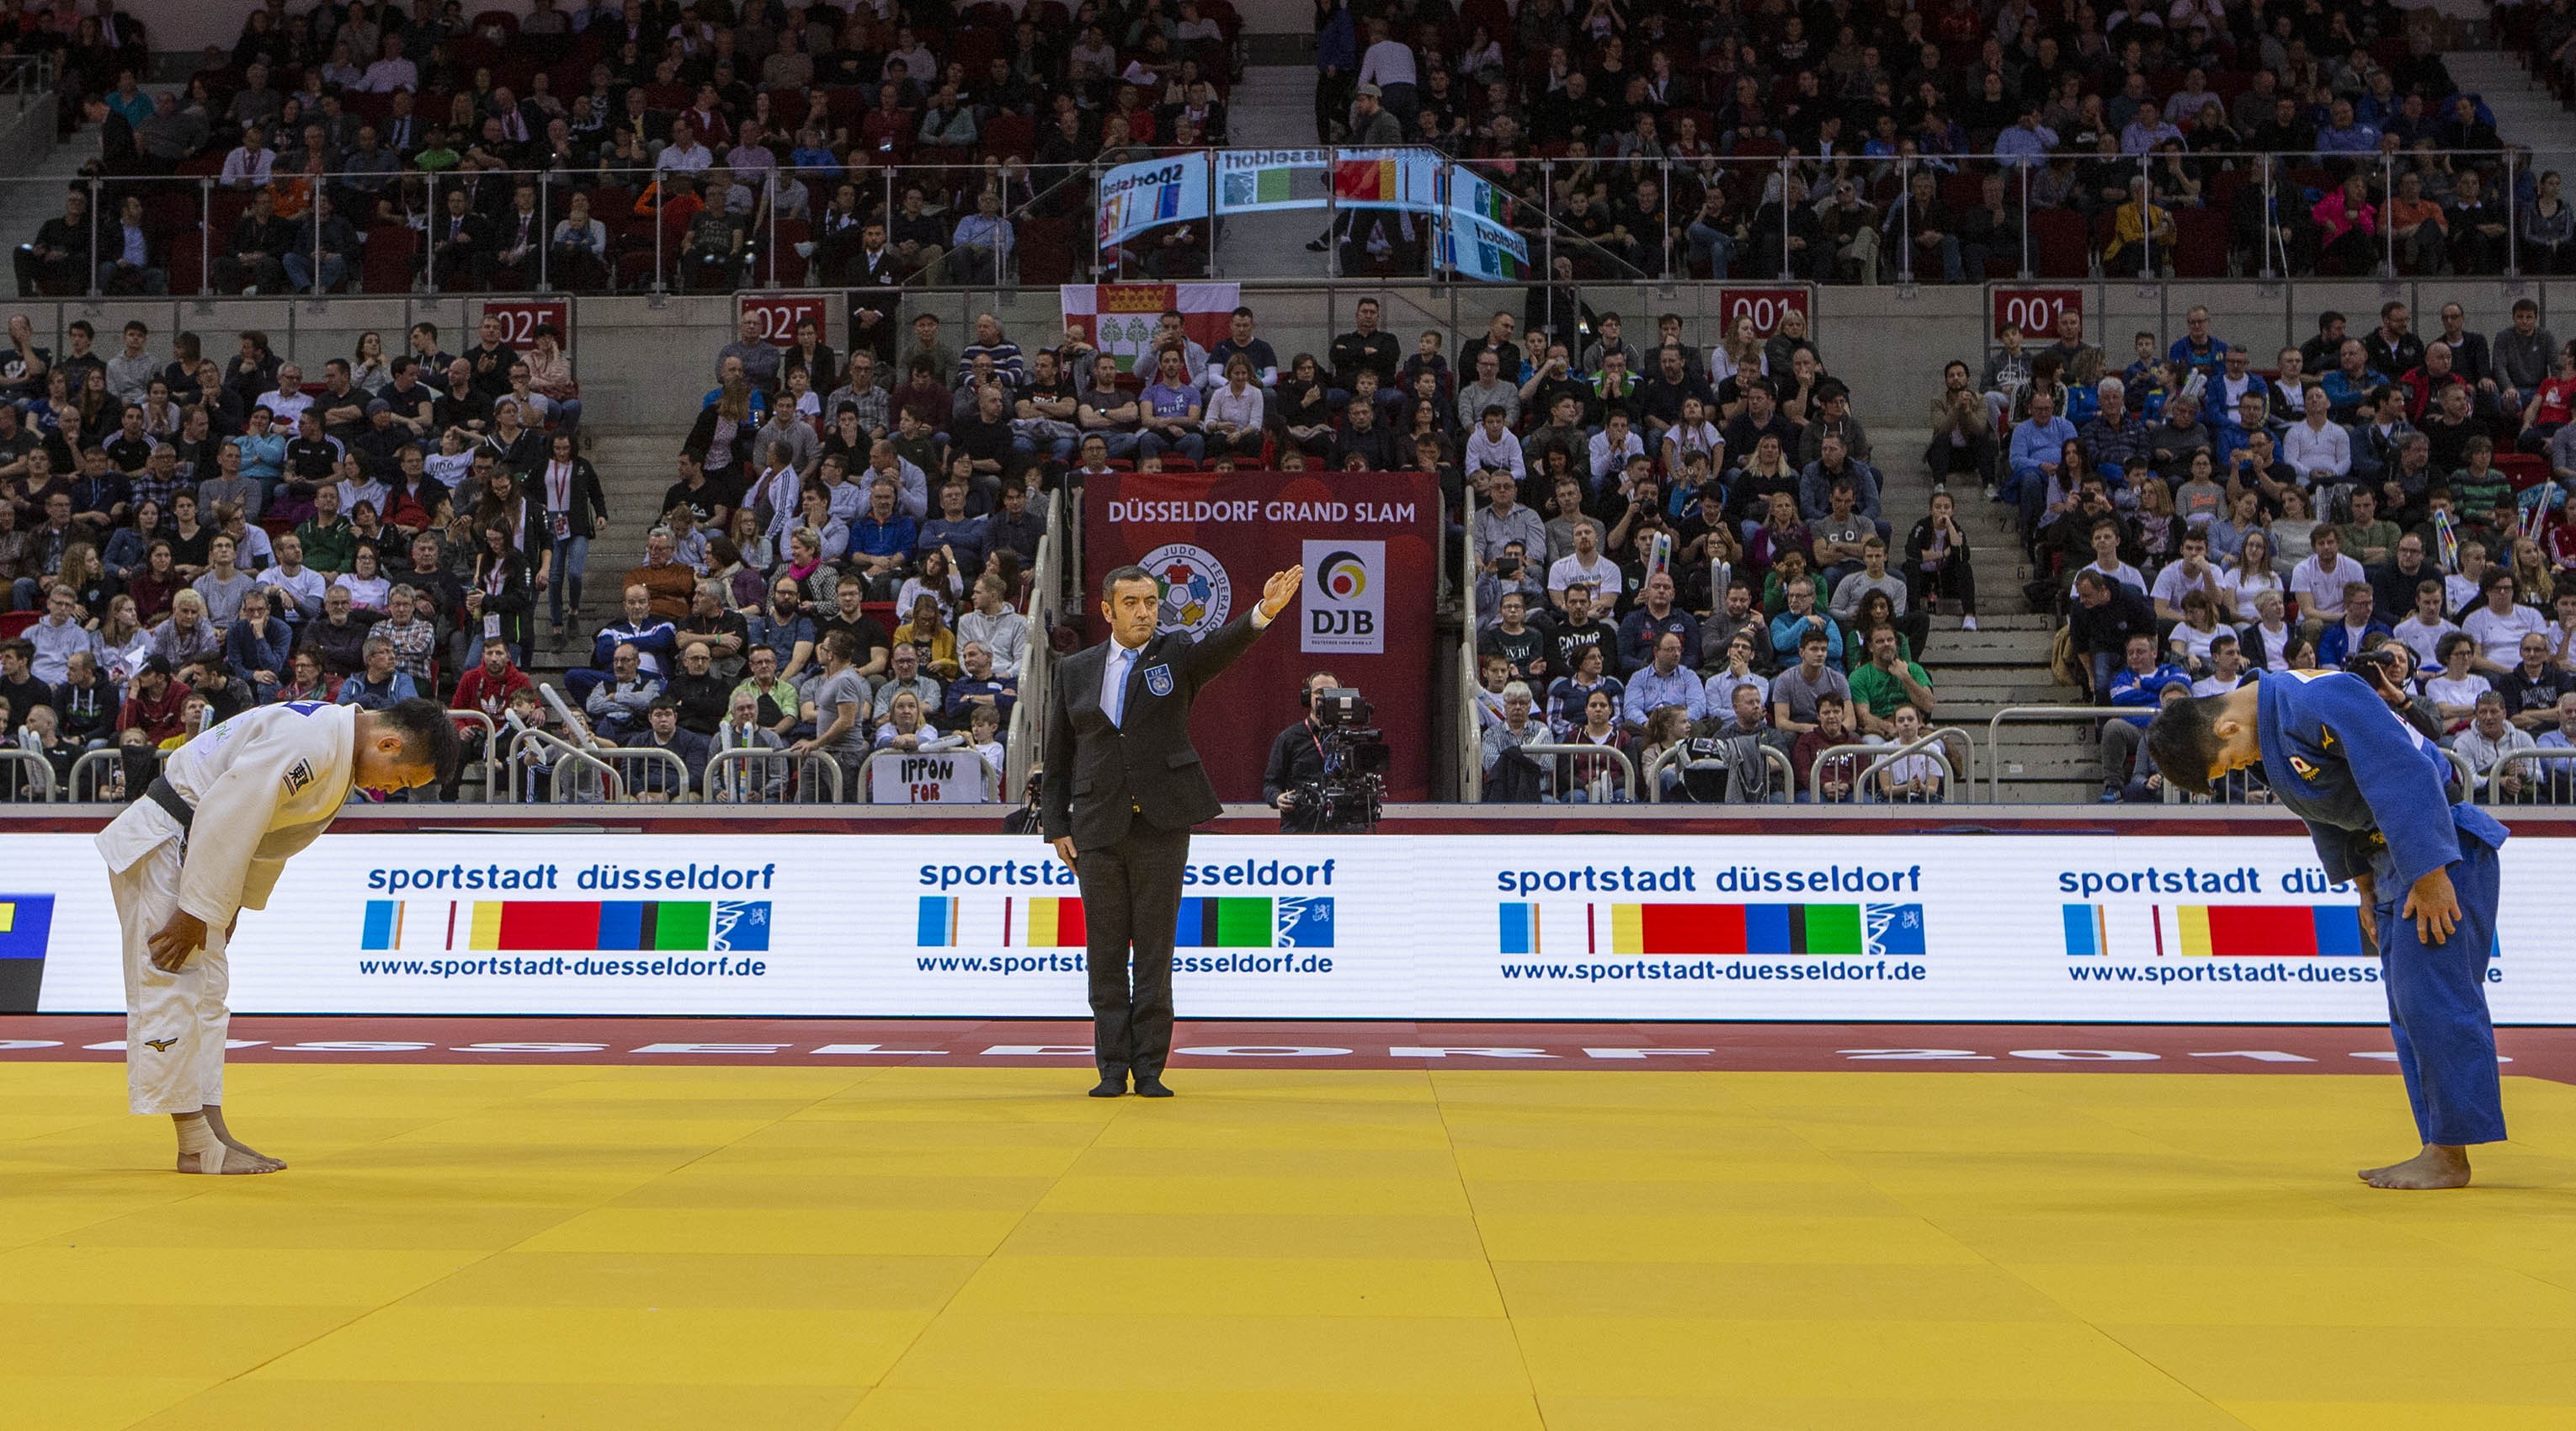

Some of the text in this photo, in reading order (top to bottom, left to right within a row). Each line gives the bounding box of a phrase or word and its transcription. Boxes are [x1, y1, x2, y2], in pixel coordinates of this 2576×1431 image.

[1109, 498, 1415, 524] DÜSSELDORF GRAND SLAM
[1163, 545, 1197, 556] JUDO
[2016, 566, 2025, 580] 6
[1310, 609, 1375, 636] DJB
[2040, 616, 2048, 630] 5
[2078, 726, 2087, 742] 3
[901, 758, 954, 784] IPPON
[911, 783, 940, 803] FOR
[367, 863, 775, 894] sportstadt düsseldorf
[919, 858, 1335, 891] sportsta sseldorf
[1498, 864, 1921, 897] sportstadt düsseldorf
[2058, 867, 2262, 899] sportstadt
[359, 956, 766, 979] www.sportstadt-duesseldorf.de
[1500, 960, 1926, 982] www.sportstadt-duesseldorf.de
